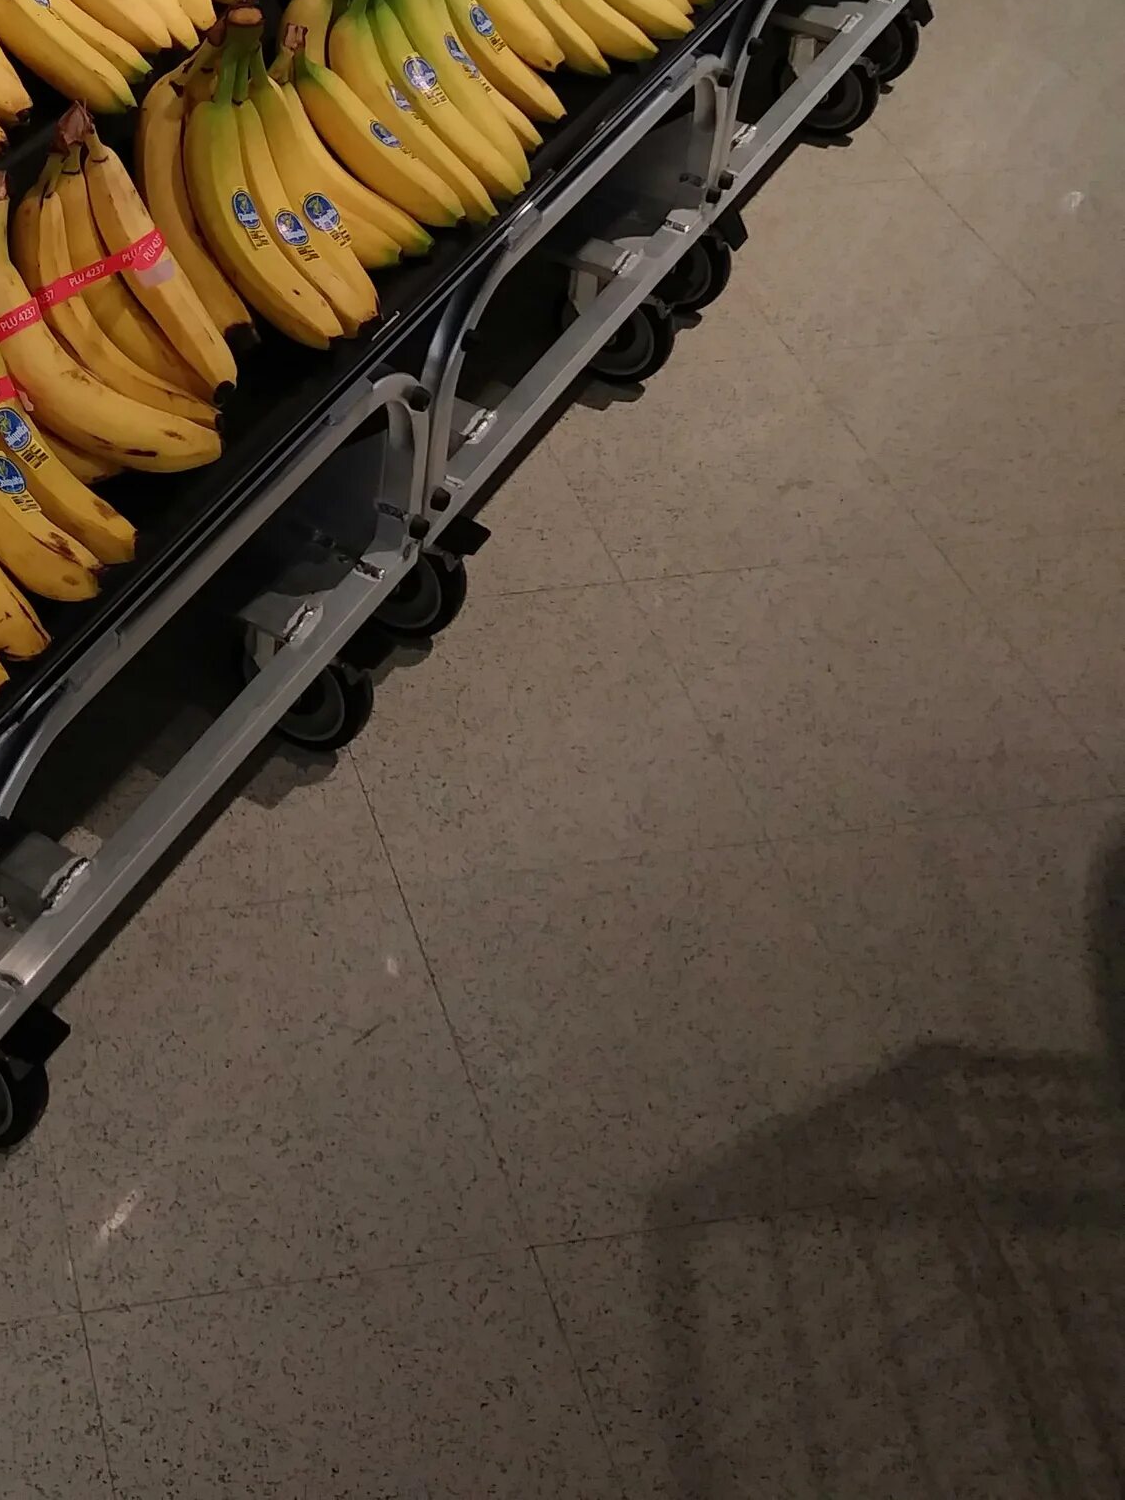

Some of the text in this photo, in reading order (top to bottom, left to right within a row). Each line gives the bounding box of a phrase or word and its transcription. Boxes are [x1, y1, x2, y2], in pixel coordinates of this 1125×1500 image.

[143, 247, 155, 262] PLU
[69, 264, 105, 287] PLU 4237
[0, 306, 37, 332] PLU 4237
